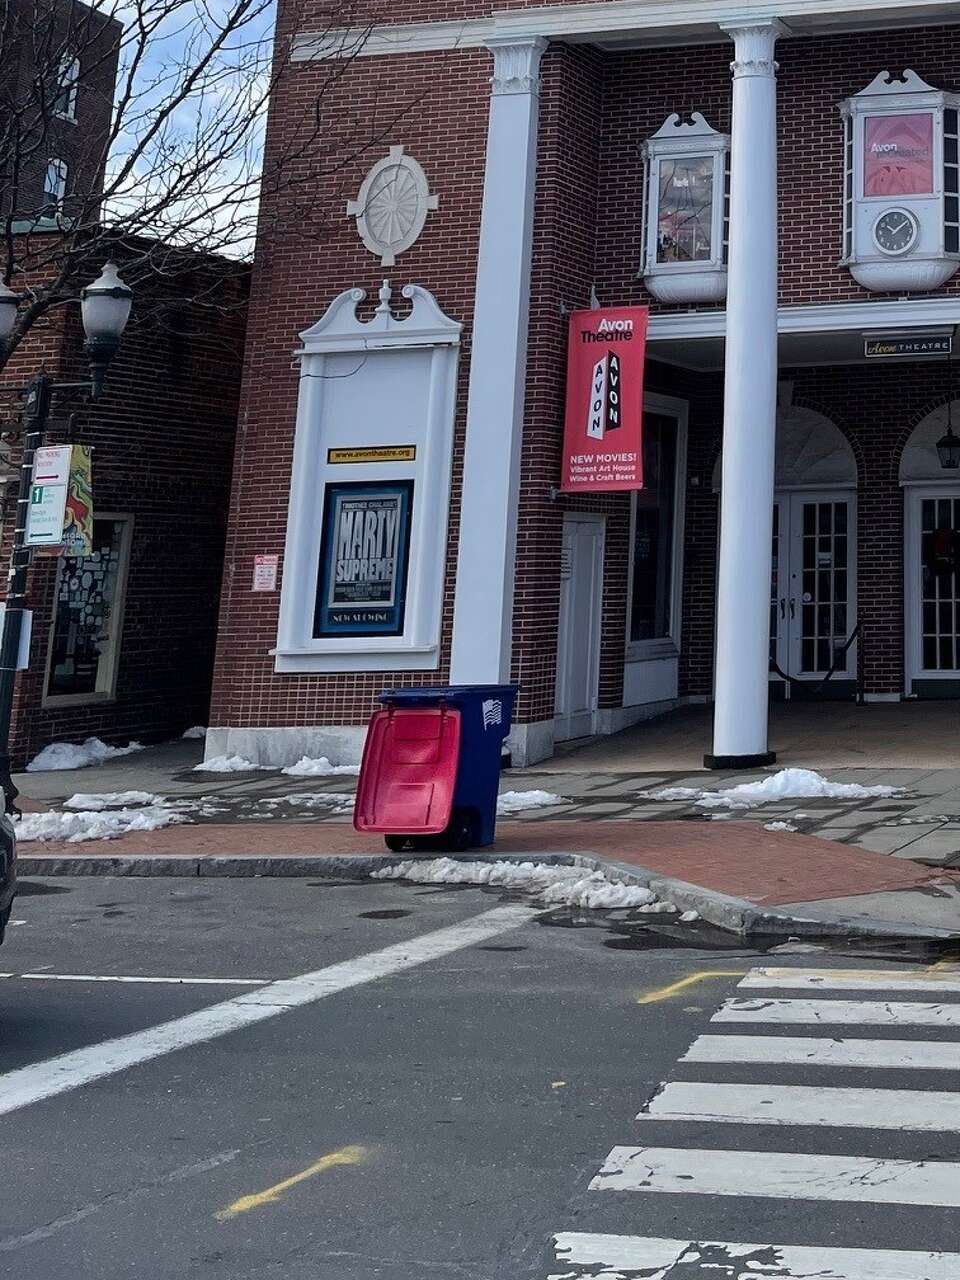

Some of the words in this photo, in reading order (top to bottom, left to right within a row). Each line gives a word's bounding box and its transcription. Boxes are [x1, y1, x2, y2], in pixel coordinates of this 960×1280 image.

[871, 143, 897, 153] Avon
[598, 318, 633, 332] Avon
[581, 329, 633, 343] Theatre
[898, 342, 948, 351] THEATRE
[609, 356, 618, 423] AVON
[592, 363, 603, 431] AVON
[570, 454, 594, 464] NEW
[596, 452, 637, 463] MOVIES!
[570, 465, 597, 473] Vibrant
[599, 464, 611, 472] Art
[612, 464, 636, 472] House
[338, 510, 398, 561] MARTY
[335, 558, 394, 583] SUPREME
